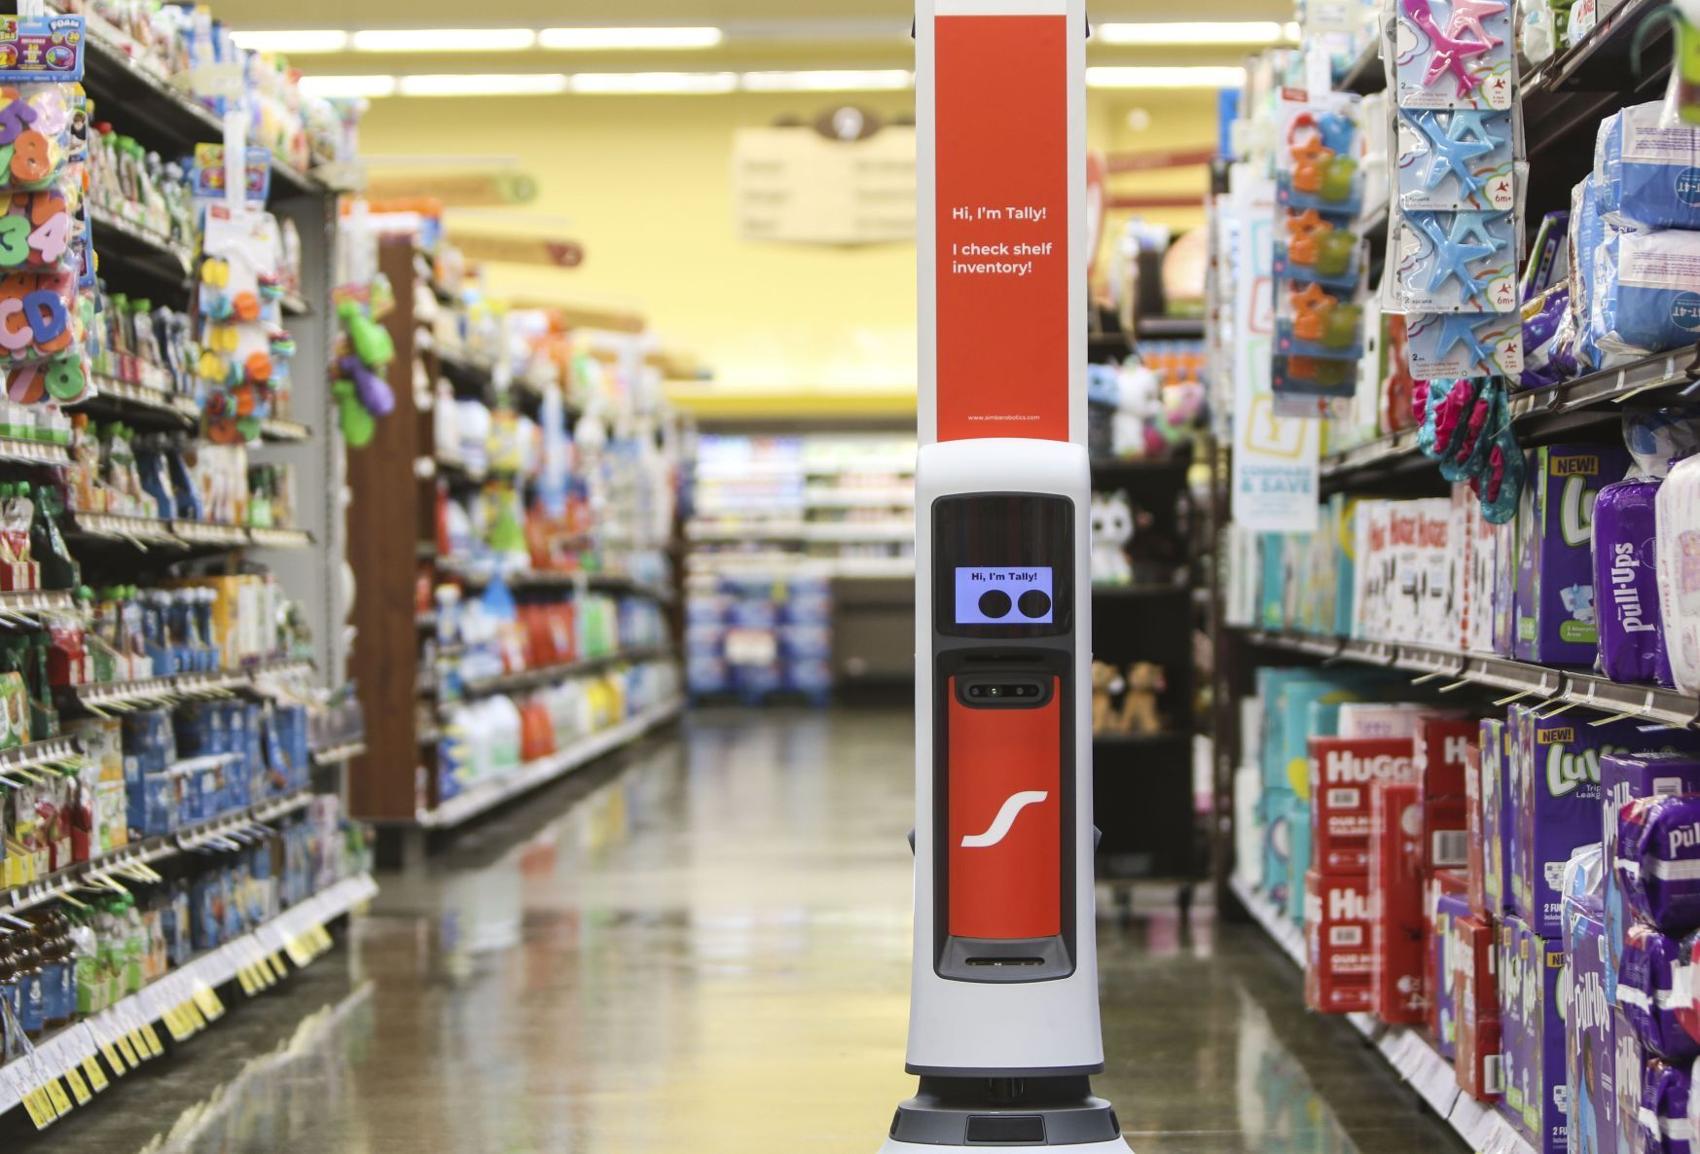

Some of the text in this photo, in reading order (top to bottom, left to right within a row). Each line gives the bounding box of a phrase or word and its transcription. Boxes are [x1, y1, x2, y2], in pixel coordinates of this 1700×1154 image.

[952, 207, 1047, 222] Hi, I'm Tally!
[952, 242, 1053, 256] I check shelf
[952, 260, 1033, 276] inventory!
[1557, 456, 1596, 474] NEW!
[971, 572, 1038, 582] Hi, I'm Tally!
[1542, 729, 1572, 742] NEW!
[1546, 742, 1612, 797] Luv
[1586, 784, 1601, 792] Trip
[1576, 791, 1601, 800] Leakg
